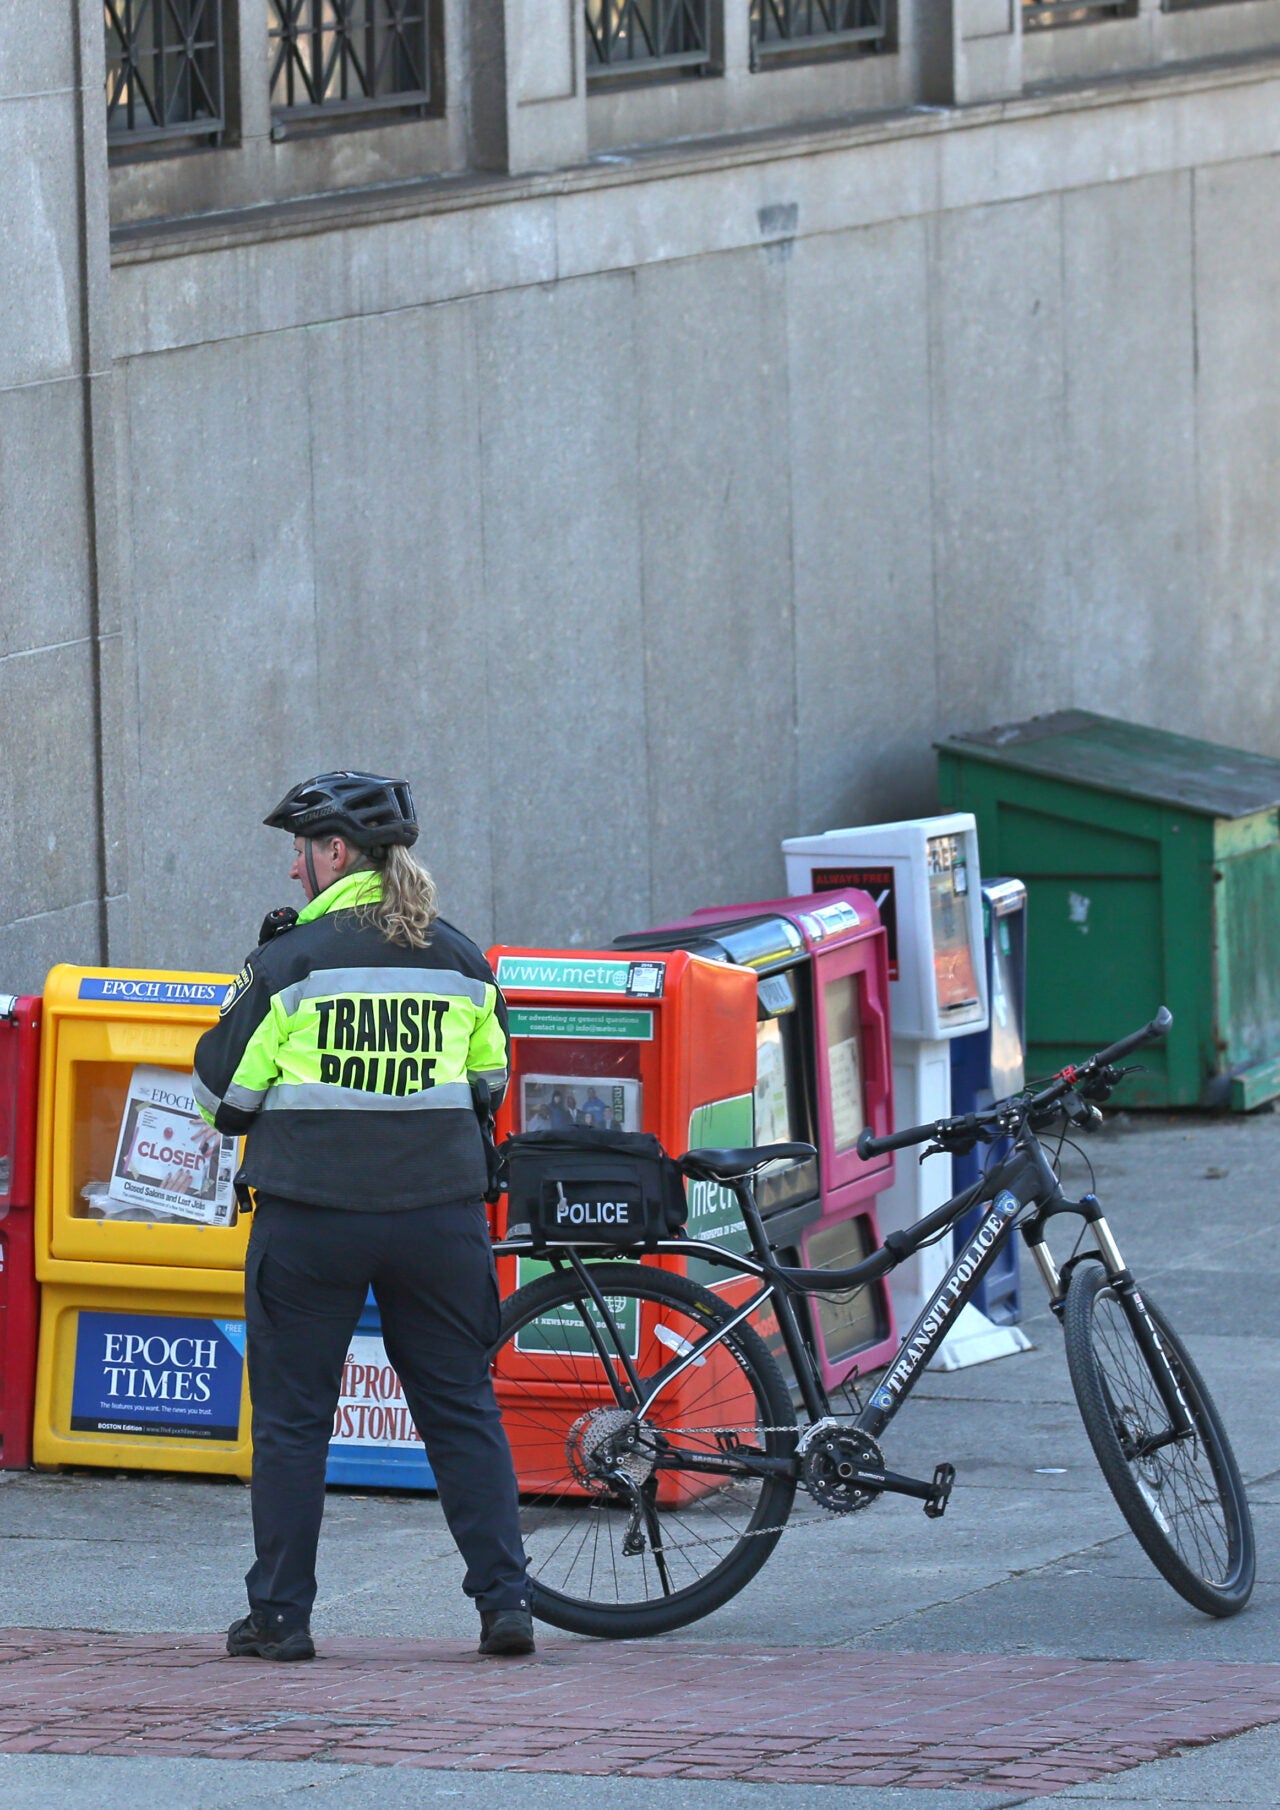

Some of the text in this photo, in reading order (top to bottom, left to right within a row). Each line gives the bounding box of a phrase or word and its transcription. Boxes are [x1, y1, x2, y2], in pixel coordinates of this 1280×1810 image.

[816, 873, 889, 884] ALWAYS FREE
[101, 980, 161, 997] EPOCH
[164, 983, 216, 999] TIMES
[314, 998, 450, 1053] TRANSIT
[319, 1053, 438, 1098] POLICE
[151, 1088, 194, 1111] EPOCH
[123, 1181, 144, 1194] Closed
[144, 1187, 166, 1200] Salons
[165, 1193, 178, 1203] and
[556, 1202, 629, 1224] POLICE
[886, 1213, 1004, 1394] TRANSIT POLICE
[224, 1323, 243, 1333] FREE
[102, 1333, 219, 1369] EPOCH
[103, 1367, 211, 1402] TIMES
[100, 1401, 110, 1409] The
[97, 1422, 122, 1430] BOSTON
[122, 1423, 143, 1432] Edition
